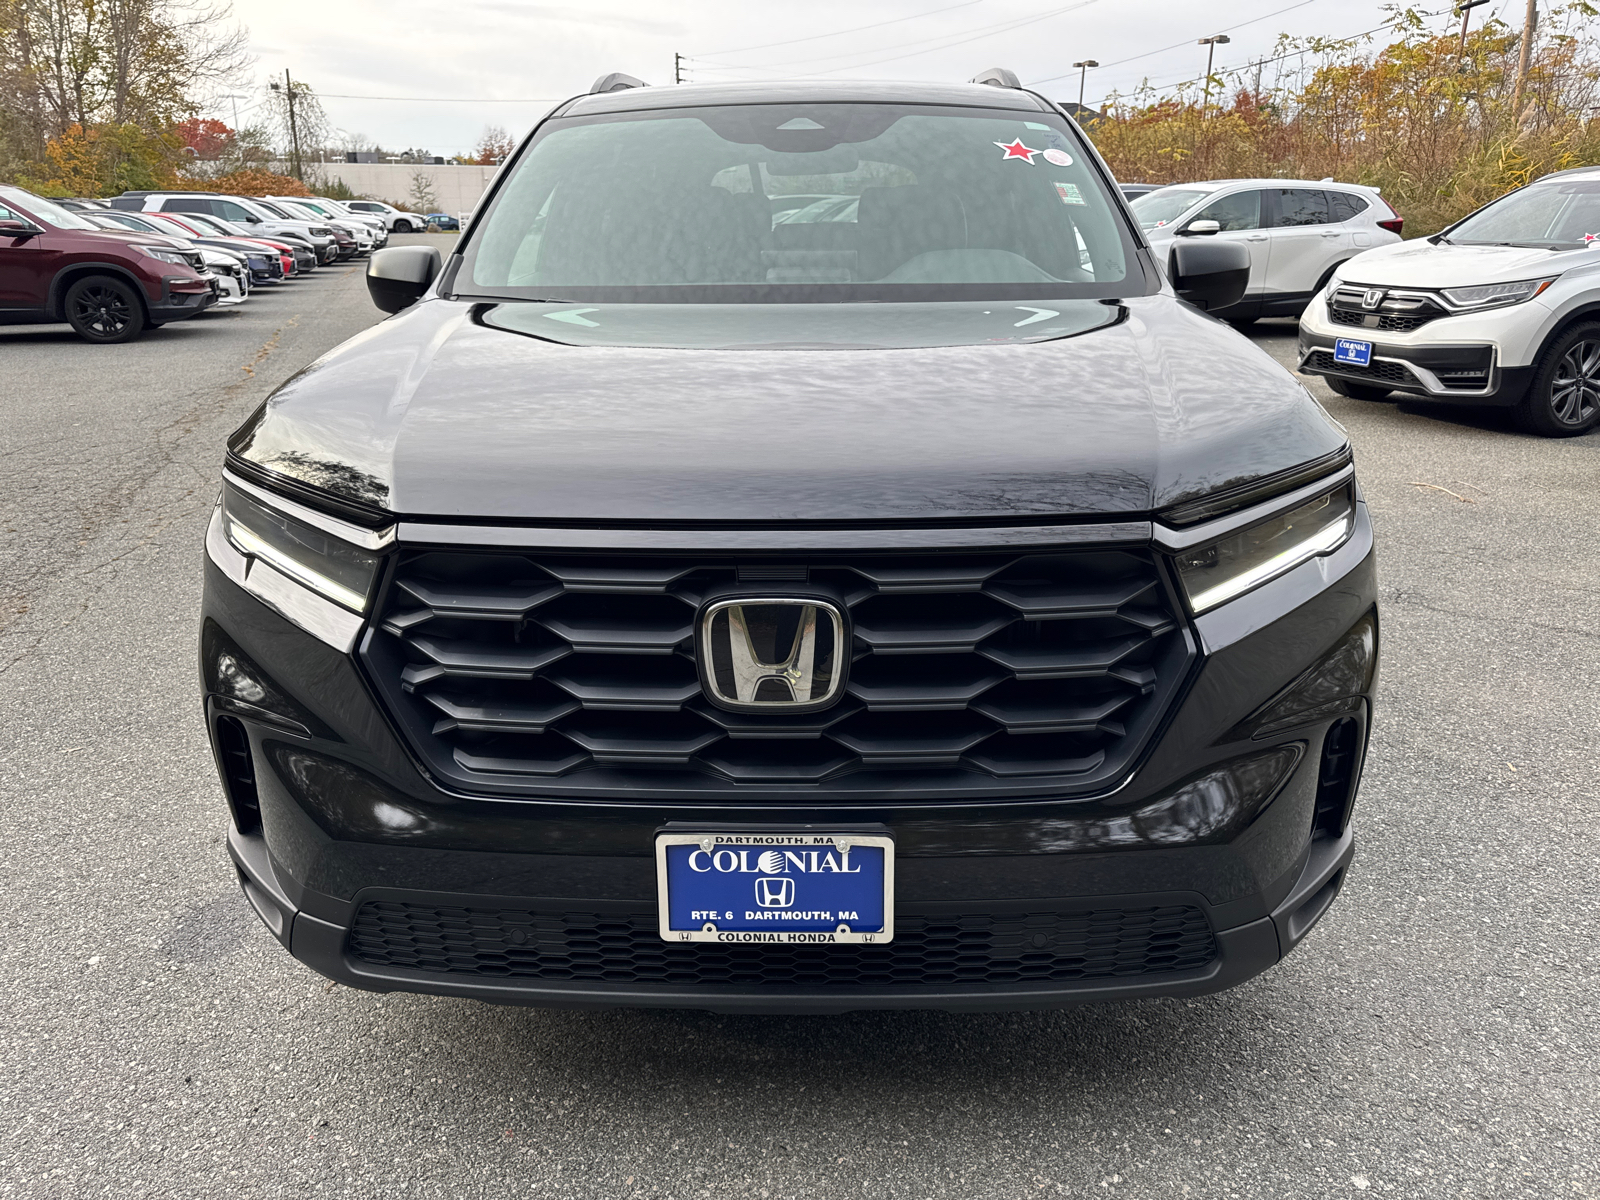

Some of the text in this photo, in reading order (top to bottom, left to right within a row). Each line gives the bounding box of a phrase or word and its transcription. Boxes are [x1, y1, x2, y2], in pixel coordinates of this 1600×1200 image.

[715, 836, 808, 845] DARTMOUTH,
[688, 850, 861, 874] COLONIAL
[691, 910, 859, 922] RTE. 6 DARTMOUTH, MA
[717, 932, 836, 943] COLONIAL HONDA
